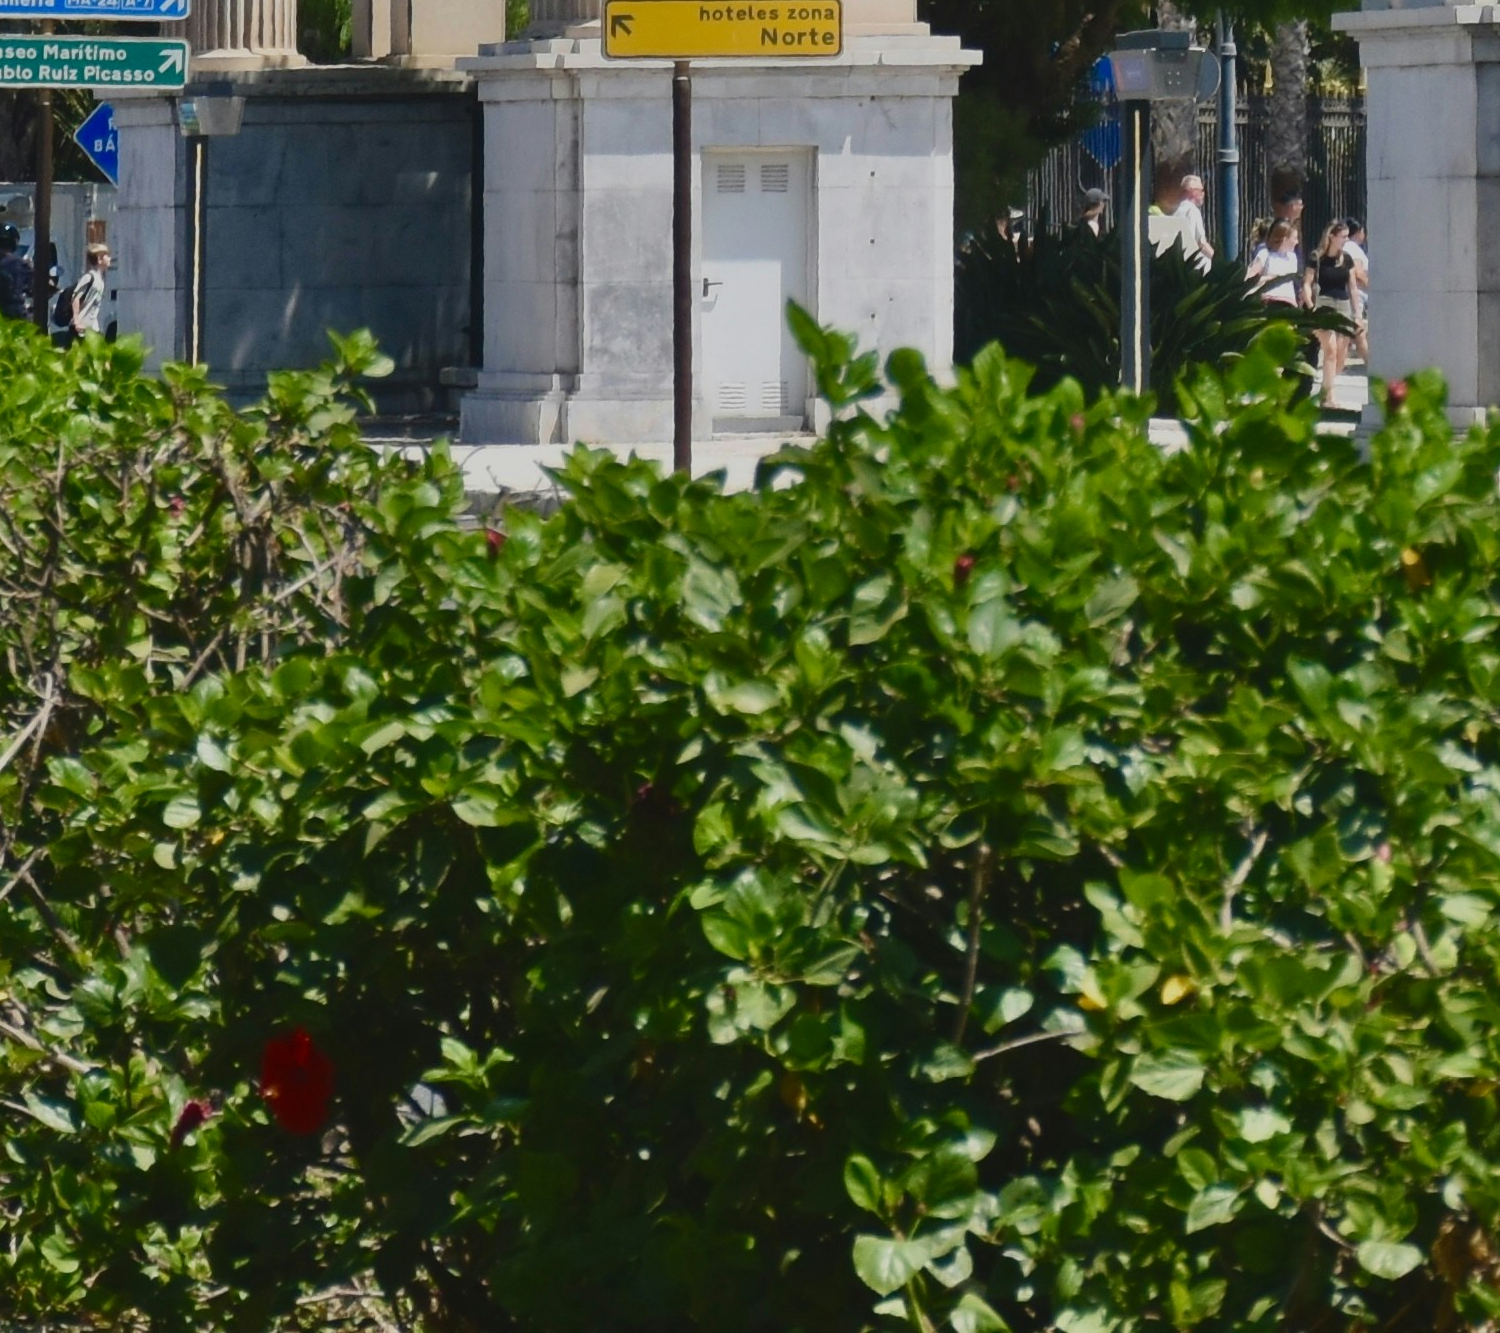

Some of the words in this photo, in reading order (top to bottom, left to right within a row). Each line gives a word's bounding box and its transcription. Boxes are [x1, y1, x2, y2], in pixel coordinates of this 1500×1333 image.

[700, 6, 779, 21] hoteles
[787, 8, 835, 21] zona
[761, 28, 835, 46] Norte
[44, 44, 127, 61] Marítimo
[39, 65, 77, 81] Ruiz
[84, 67, 155, 82] Picasso
